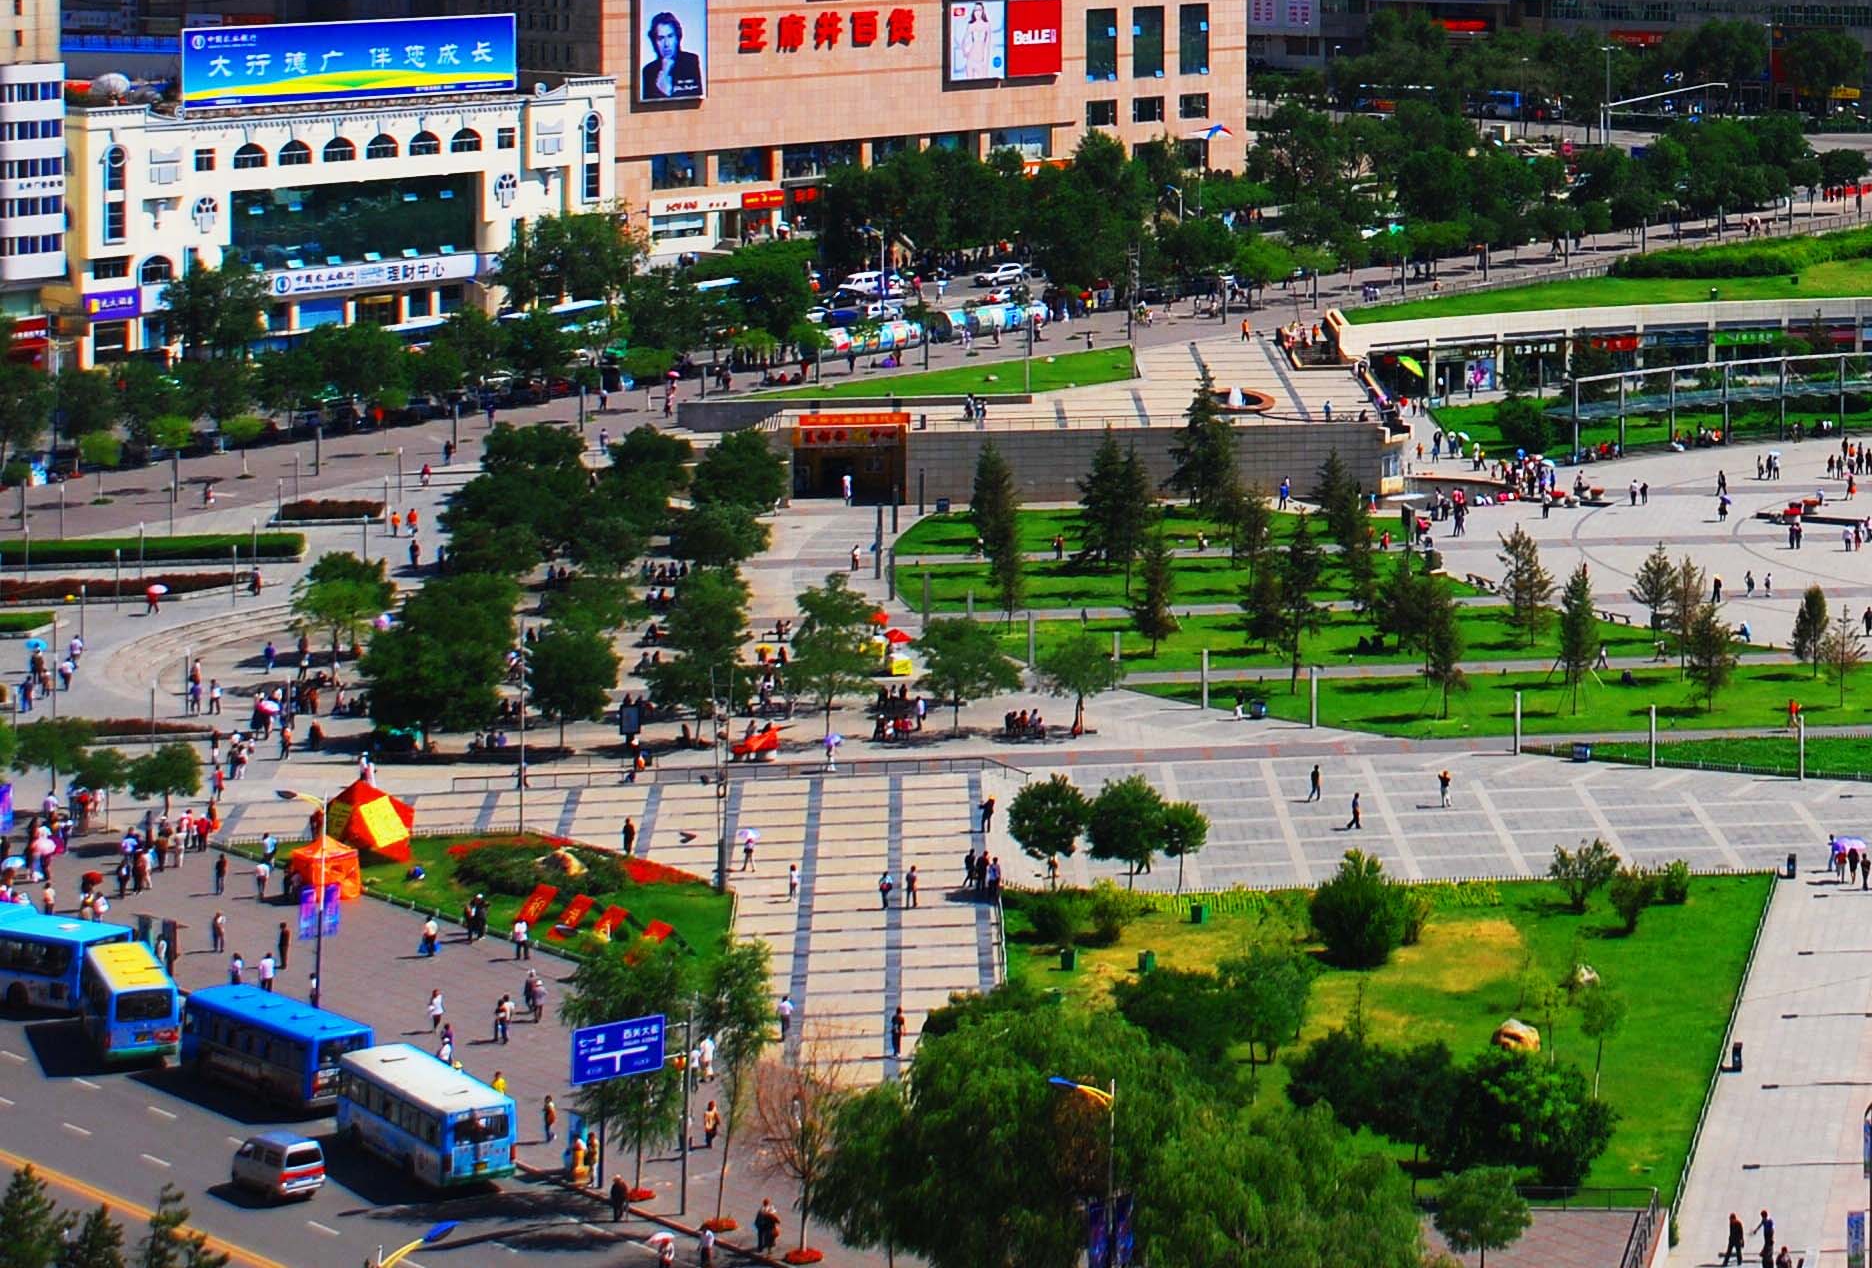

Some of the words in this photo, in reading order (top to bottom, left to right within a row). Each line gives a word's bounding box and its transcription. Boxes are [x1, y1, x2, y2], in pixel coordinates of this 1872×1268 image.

[369, 41, 493, 68] 伴您成长
[295, 271, 355, 284] 中国农业银行
[387, 262, 445, 282] 理财中心
